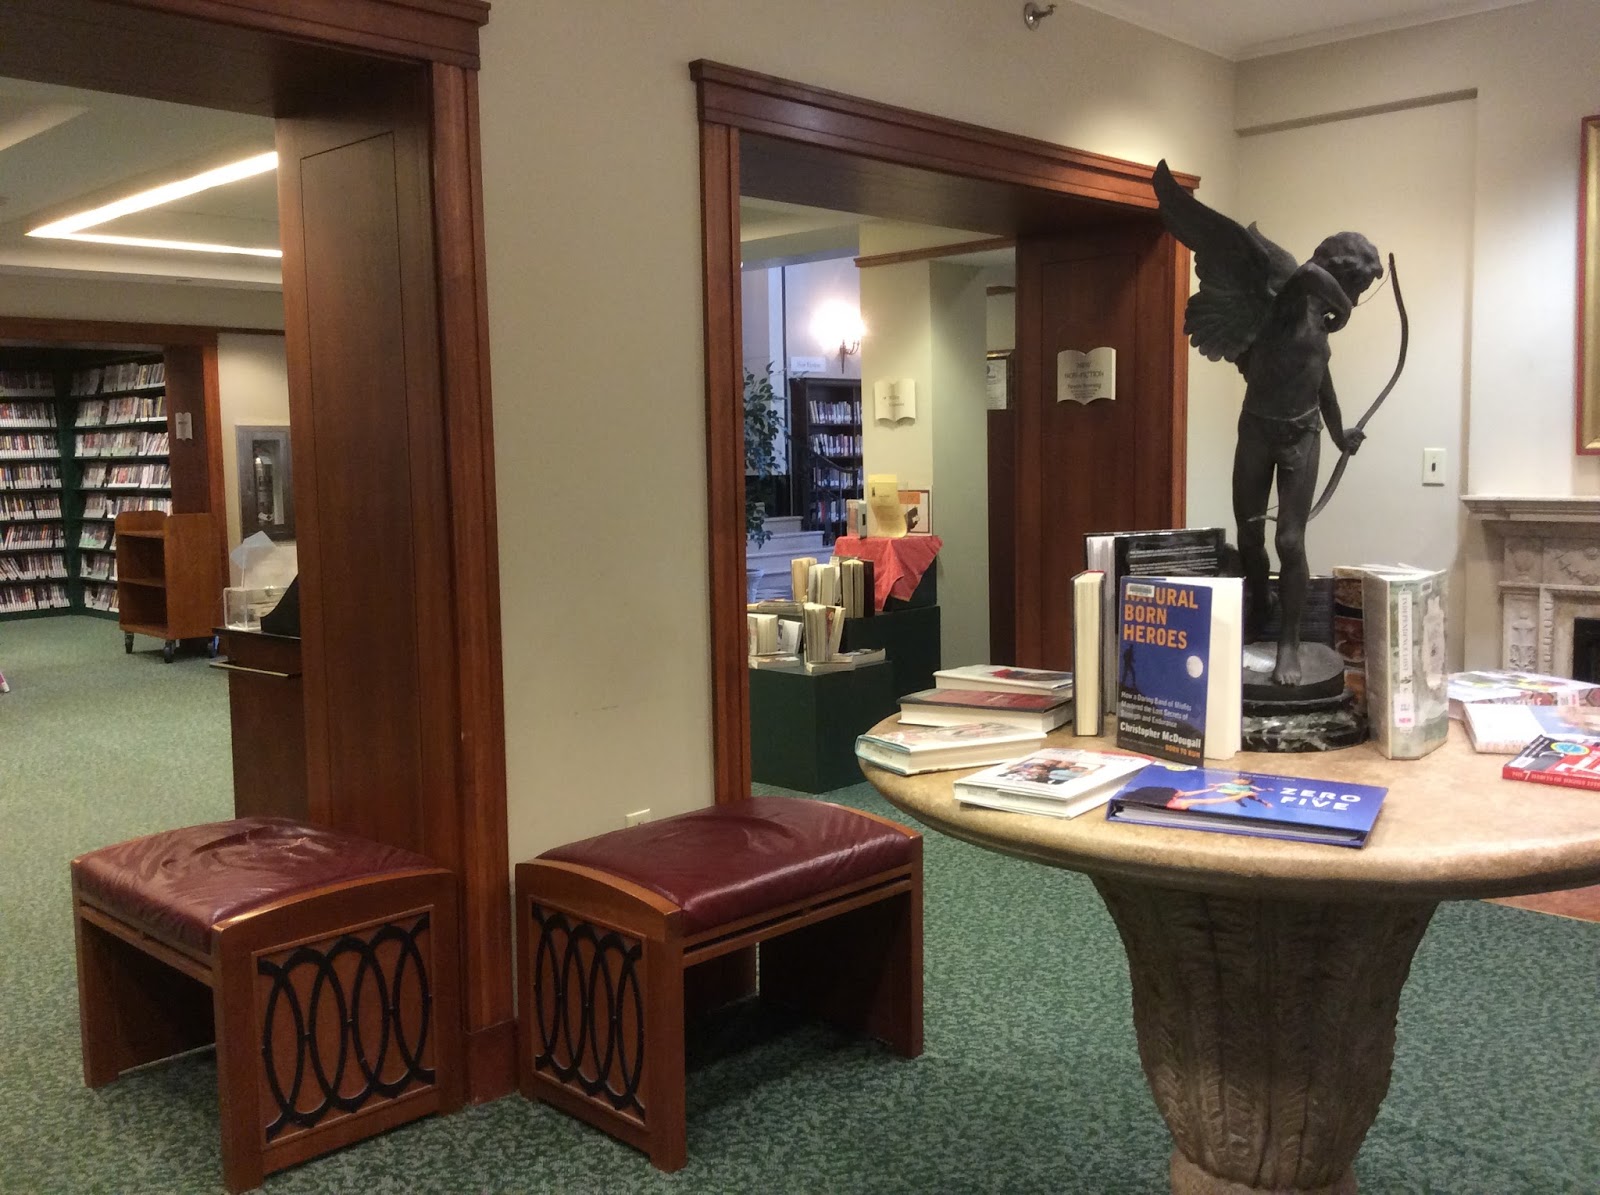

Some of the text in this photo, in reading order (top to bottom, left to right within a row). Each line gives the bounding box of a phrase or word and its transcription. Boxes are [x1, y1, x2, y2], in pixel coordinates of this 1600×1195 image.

[1124, 604, 1167, 625] BORN
[1123, 624, 1187, 649] HEROES
[1121, 691, 1133, 700] How
[1137, 694, 1154, 704] Daring
[1168, 700, 1174, 708] of
[1182, 713, 1189, 721] of
[1120, 721, 1161, 739] Christopher
[1161, 730, 1202, 749] McDougall
[1523, 770, 1531, 781] 7
[1280, 787, 1361, 802] ZERO
[1280, 796, 1350, 811] FIVE
